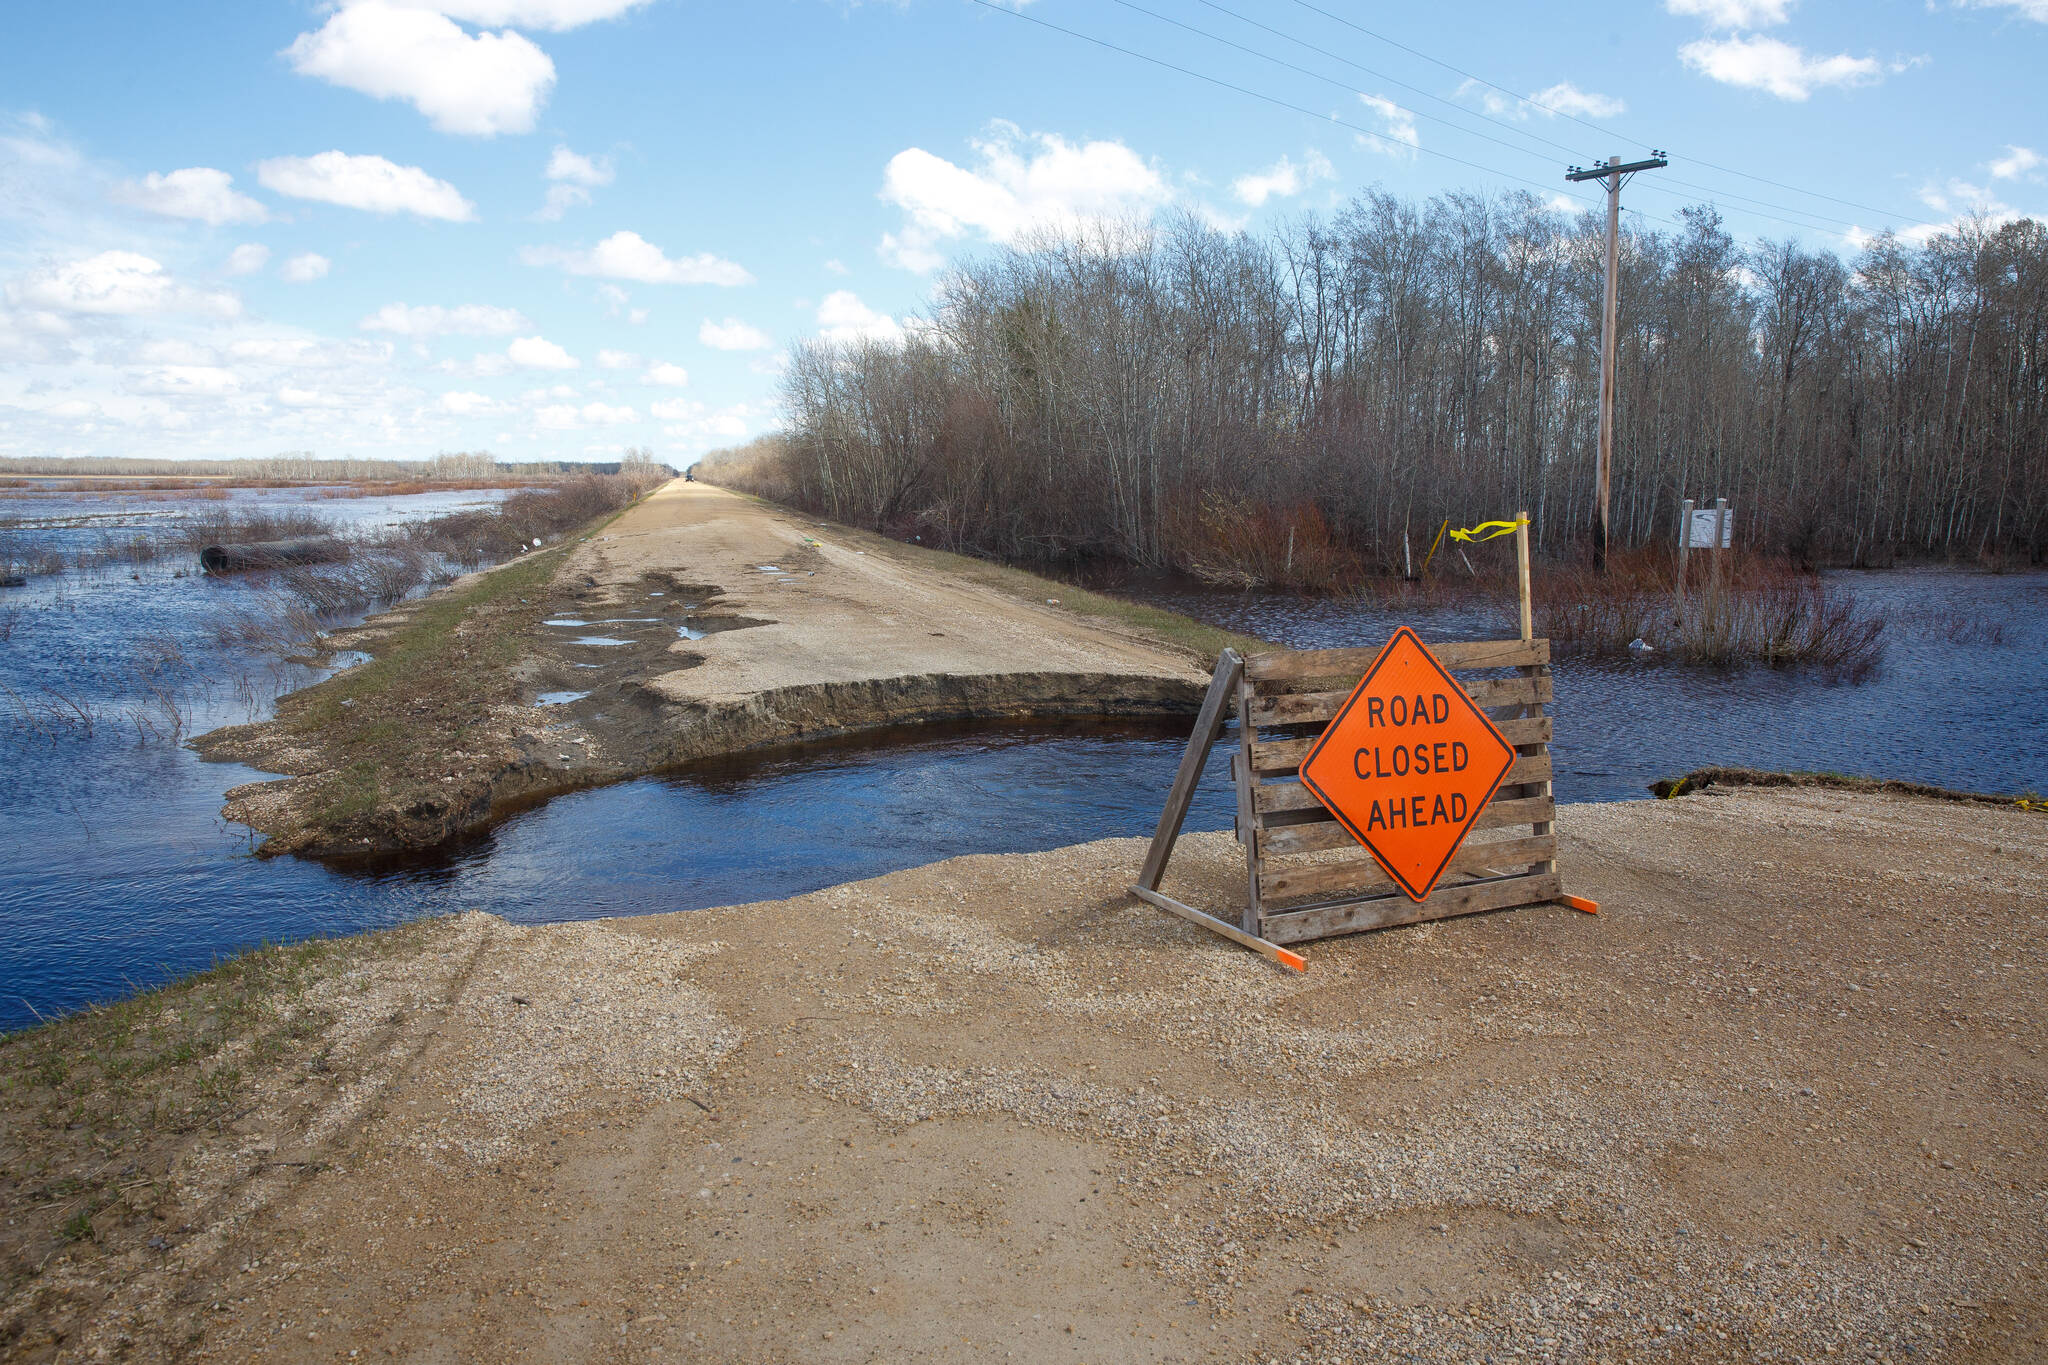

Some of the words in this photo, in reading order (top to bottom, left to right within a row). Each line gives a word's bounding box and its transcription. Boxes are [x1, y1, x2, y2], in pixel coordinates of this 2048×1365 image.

[1367, 694, 1449, 728] ROAD
[1354, 741, 1468, 780] CLOSED
[1367, 793, 1467, 832] AHEAD
